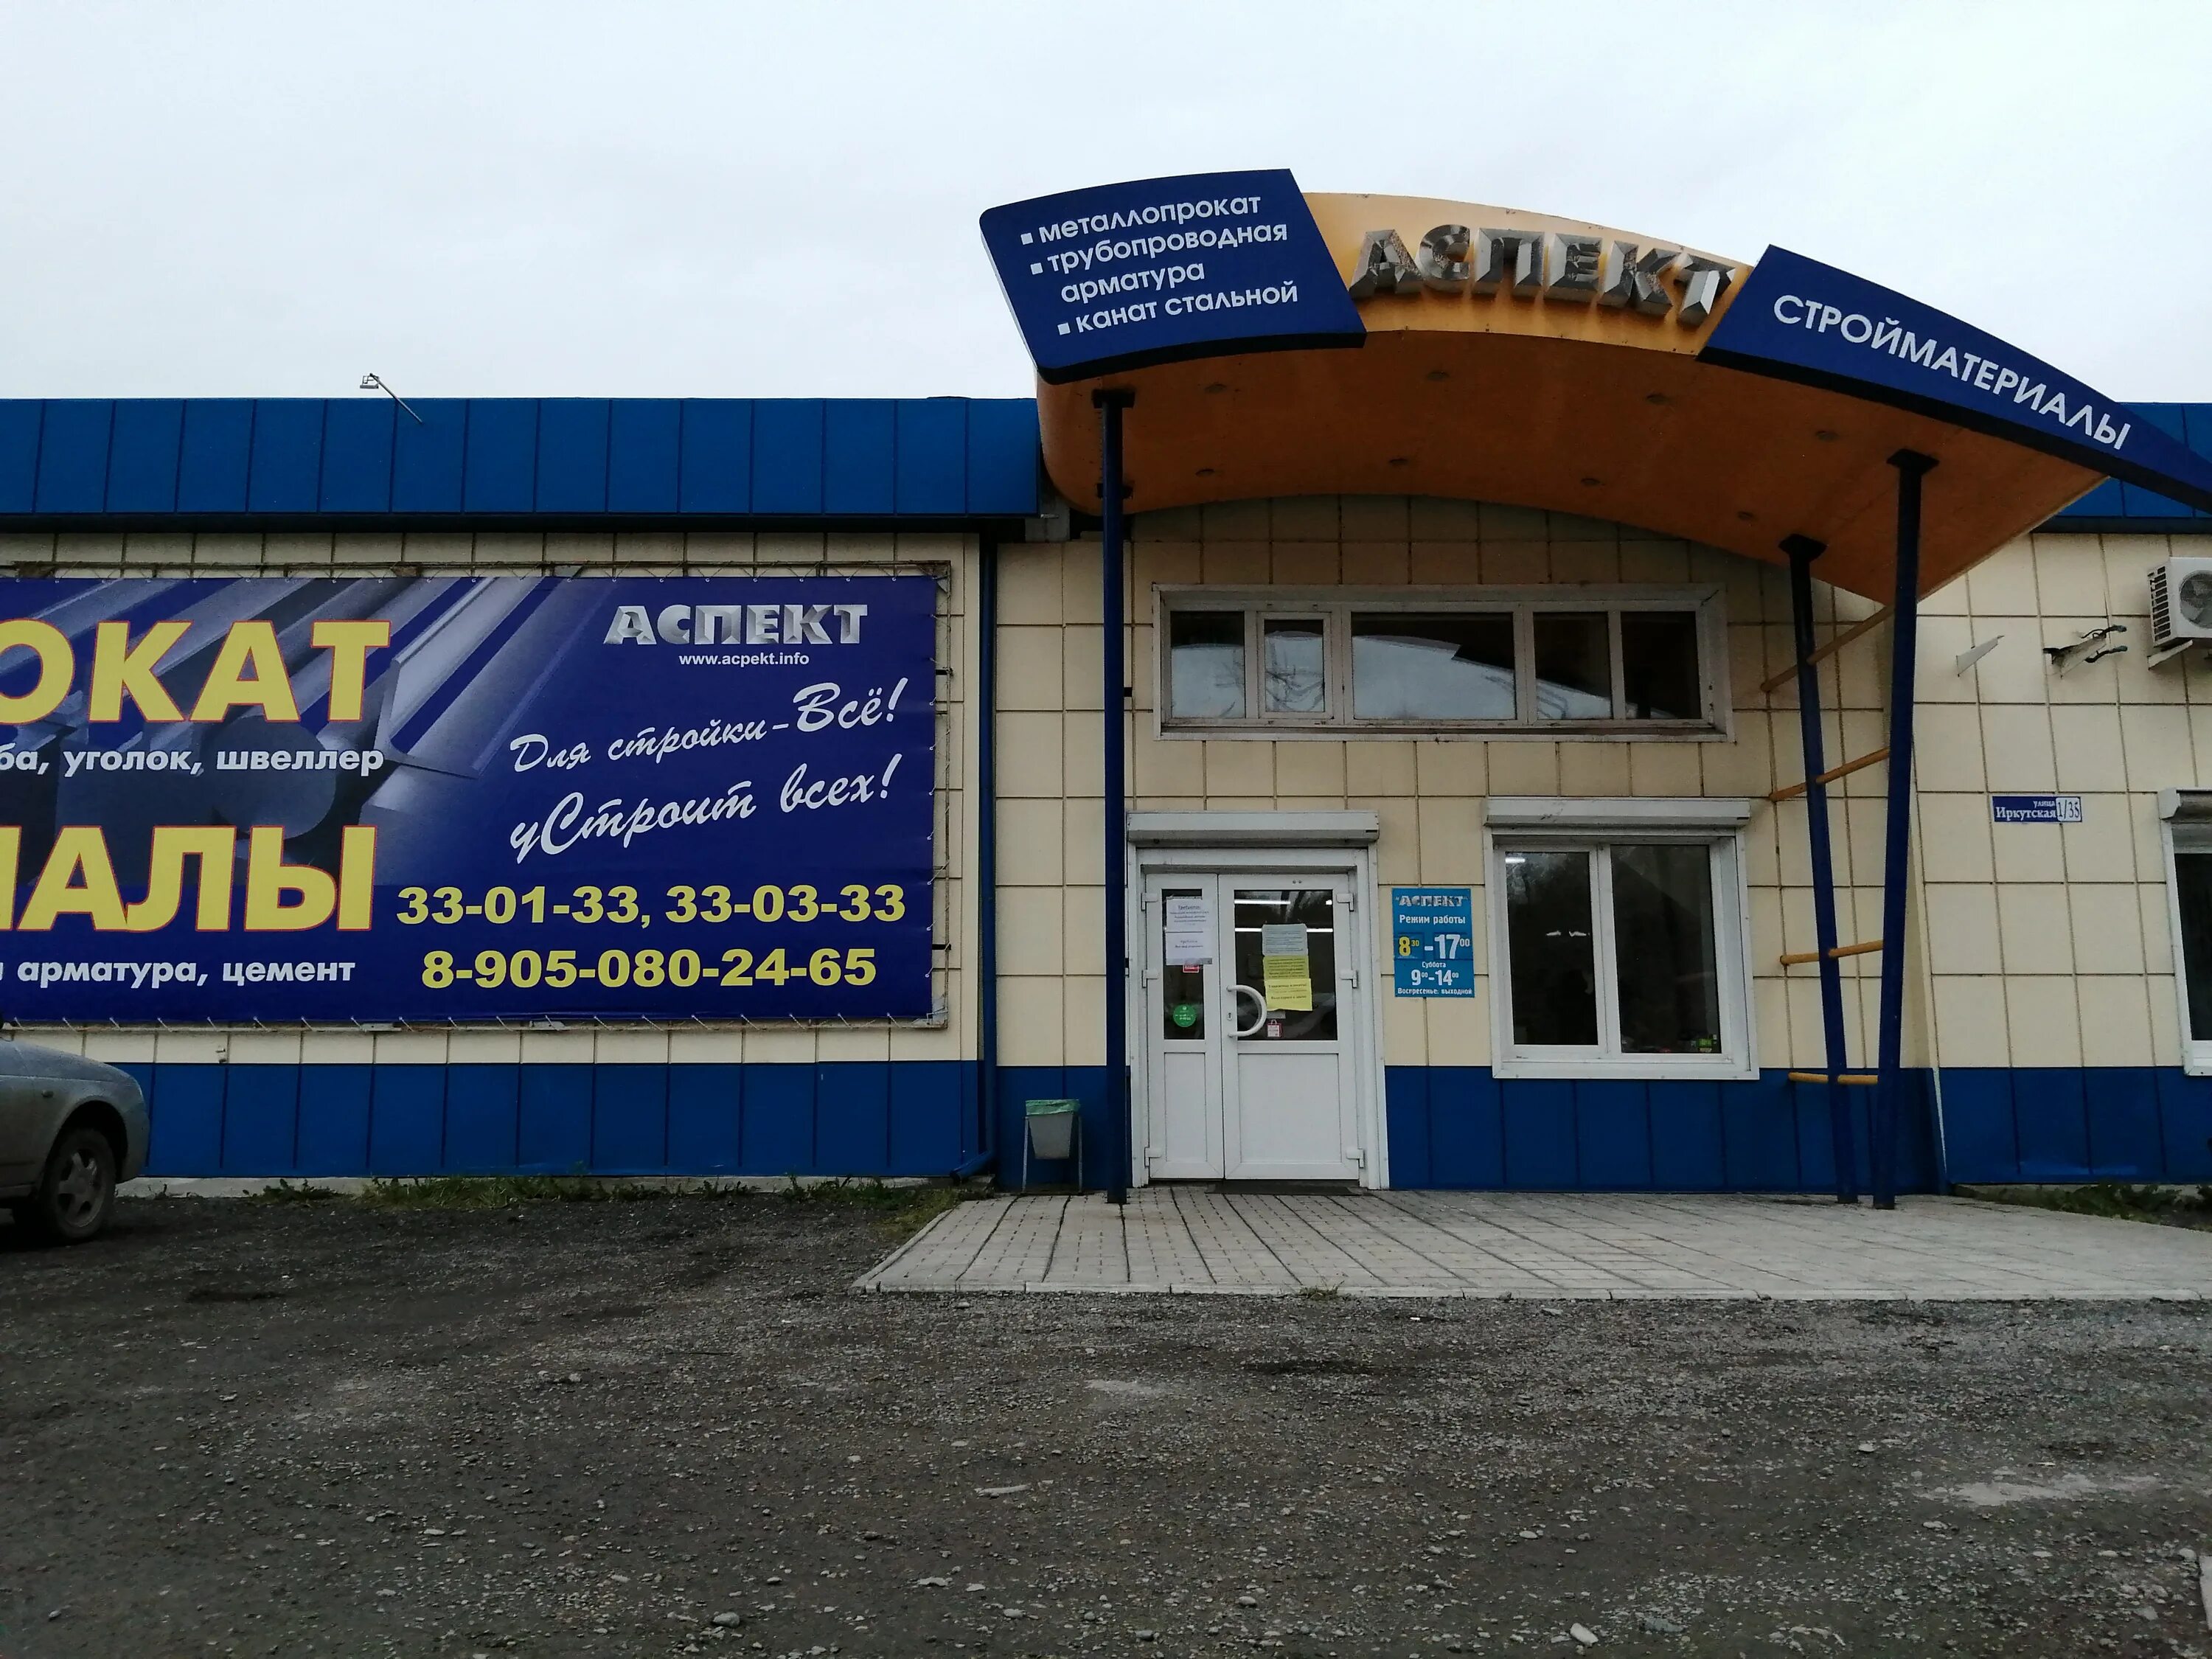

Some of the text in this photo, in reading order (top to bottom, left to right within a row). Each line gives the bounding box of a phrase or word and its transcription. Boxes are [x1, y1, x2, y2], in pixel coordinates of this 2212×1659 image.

[1039, 195, 1261, 243] металлопрокат
[1048, 223, 1287, 274] трубопроводная
[1061, 261, 1206, 304] арматура
[1349, 223, 1736, 326] АСПЕКТ
[1076, 280, 1298, 333] канат стальной
[1774, 295, 2132, 450] СТРОЙМАТЕРИАЛЫ
[603, 604, 868, 645] АСПЕКТ
[678, 652, 810, 667] www.acpekt.info
[63, 751, 202, 776] уголок,
[217, 750, 383, 776] швеллер
[510, 734, 591, 772] Для
[510, 754, 902, 863] уСтроит всех!
[1996, 807, 2057, 821] Иркутская
[2033, 801, 2056, 809] улица
[0, 825, 378, 932] АЛЫ
[397, 885, 905, 929] 33-01-33, 33-03-33
[1399, 914, 1466, 925] Режим работы
[17, 961, 209, 989] арматура,
[223, 961, 355, 987] цемент
[422, 948, 877, 989] 8-905-080-24-65
[1422, 961, 1447, 969] Суббота
